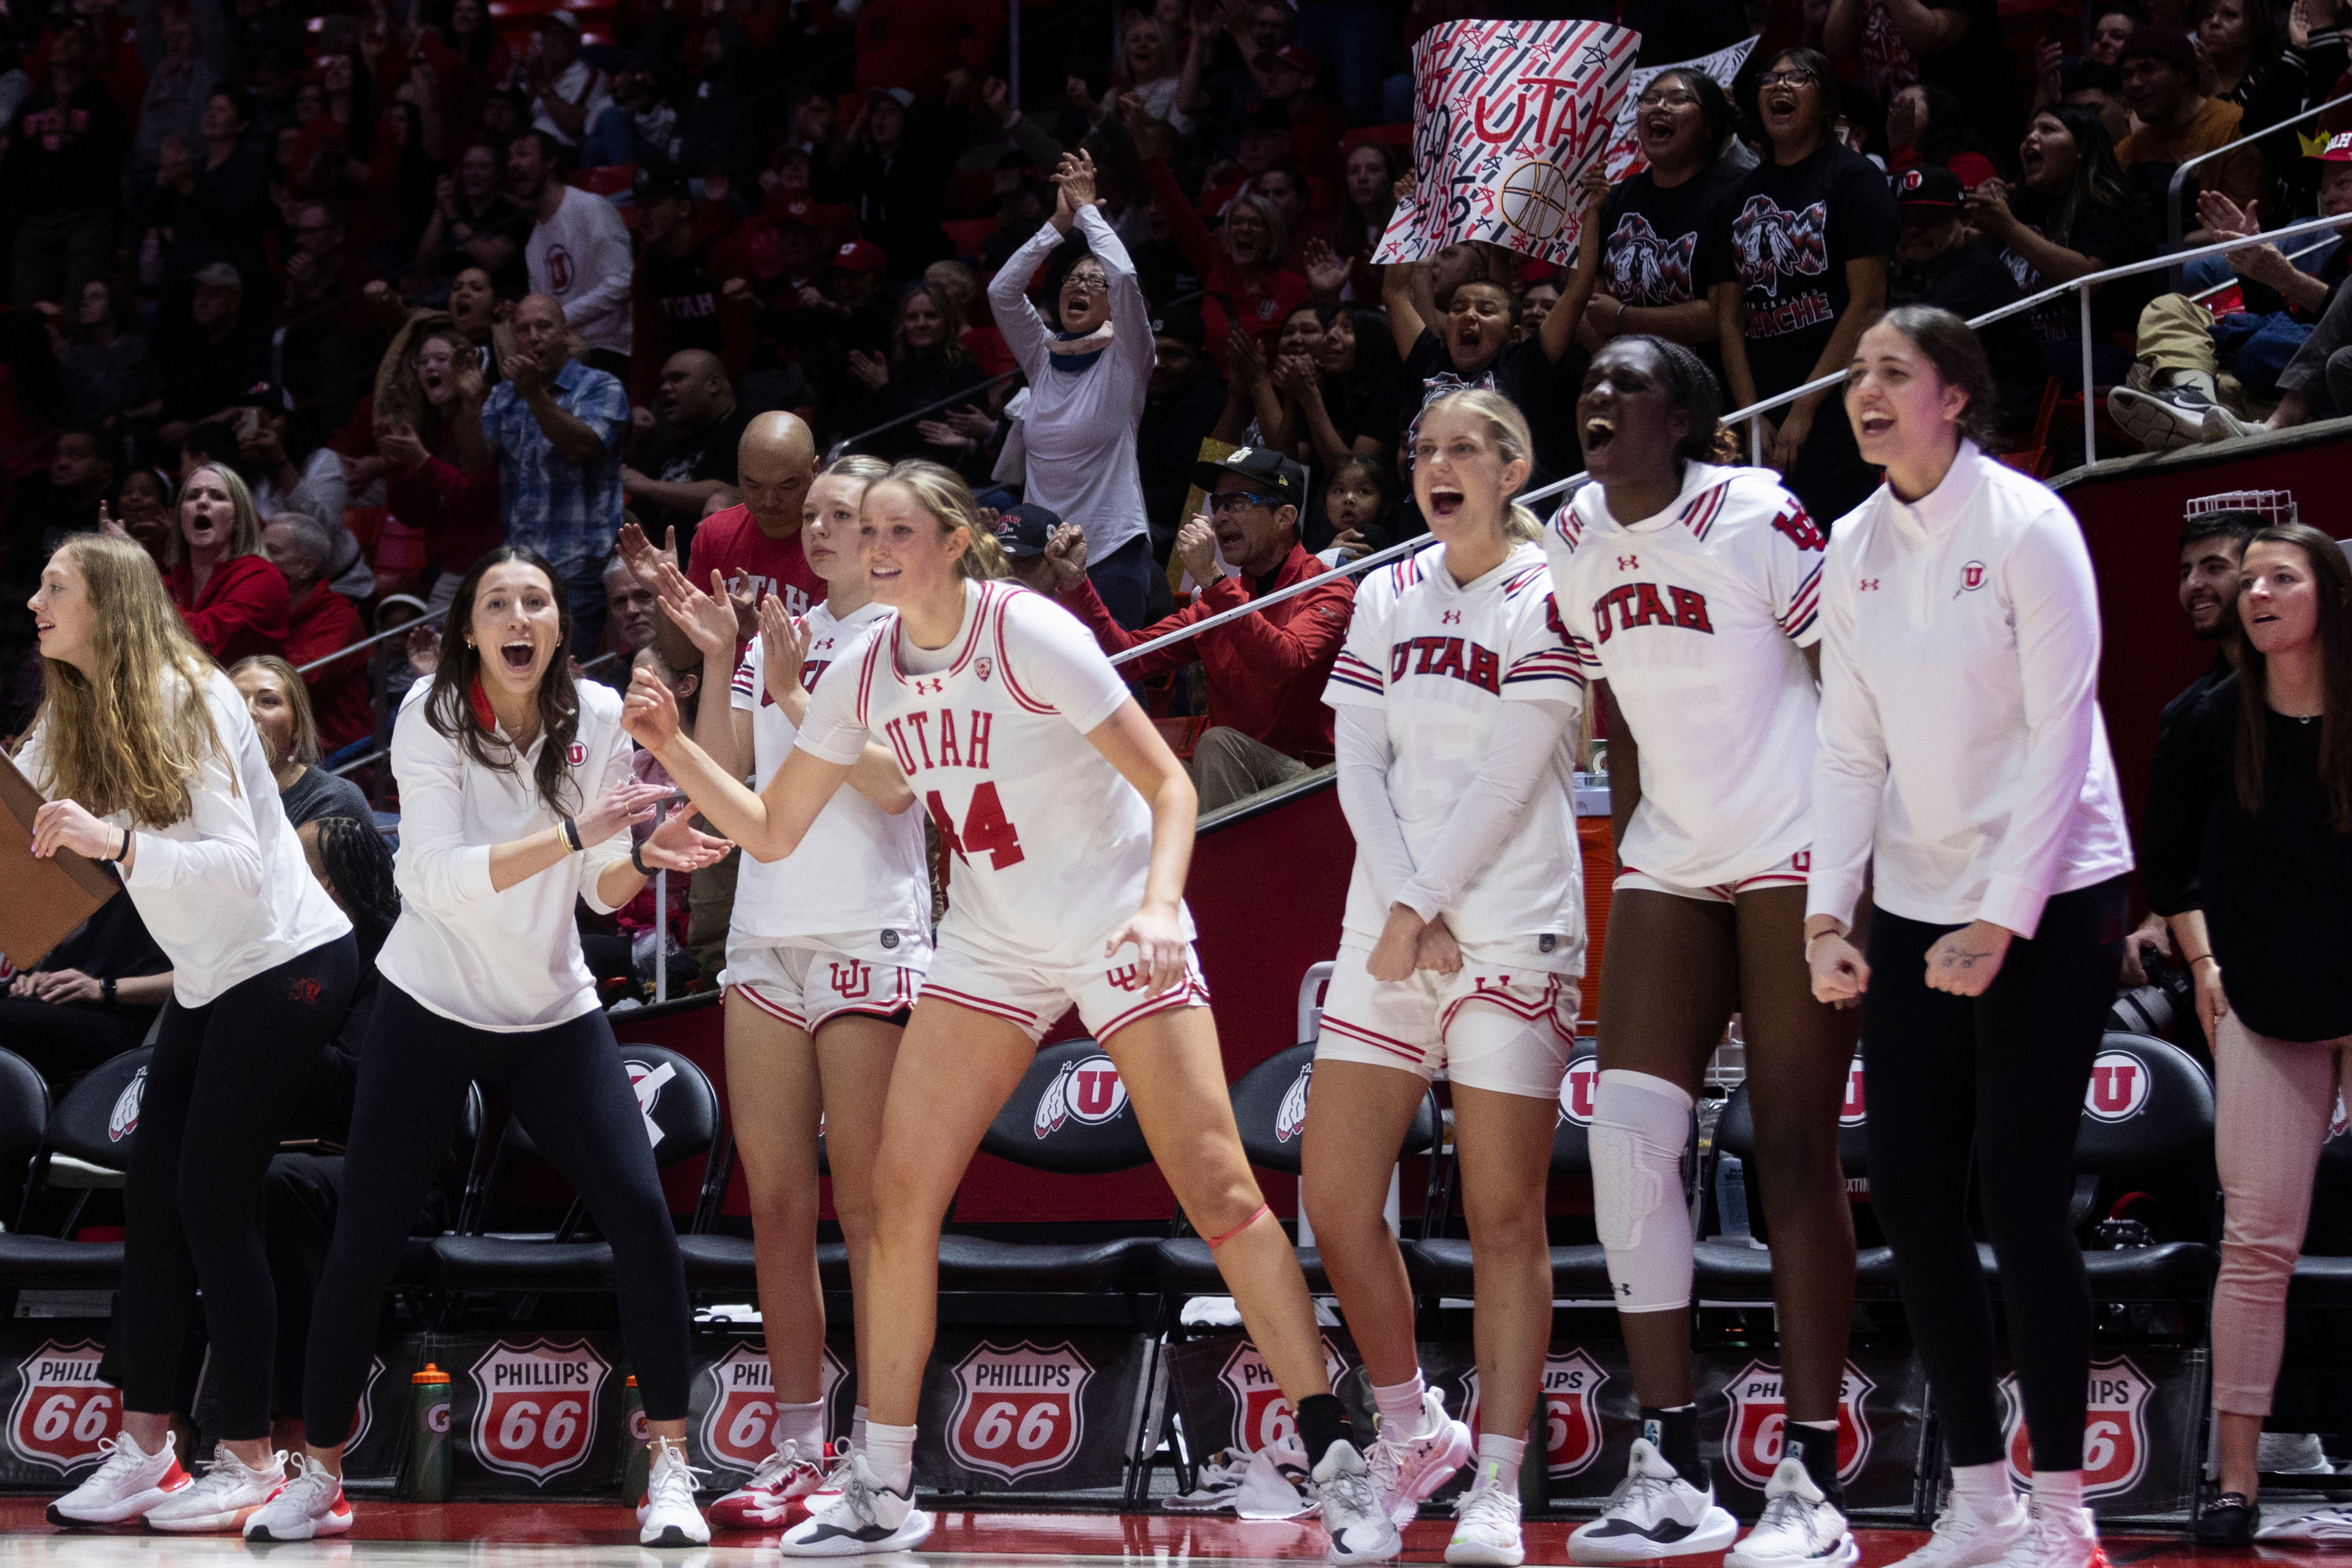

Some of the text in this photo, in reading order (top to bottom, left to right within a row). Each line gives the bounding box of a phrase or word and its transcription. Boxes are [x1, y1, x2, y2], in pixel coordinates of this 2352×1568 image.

[1965, 567, 1983, 587] U
[1592, 583, 1715, 644] UTAH
[1391, 636, 1501, 696] UTAH
[568, 745, 583, 764] U
[885, 709, 993, 776] UTAH
[1077, 1070, 1119, 1115] U
[2089, 1065, 2144, 1112] U
[495, 1362, 590, 1386] PHILLIPS
[975, 1364, 1071, 1387] PHILLIPS
[32, 1394, 114, 1442] 66
[499, 1400, 582, 1450] 66
[973, 1402, 1060, 1450] 66
